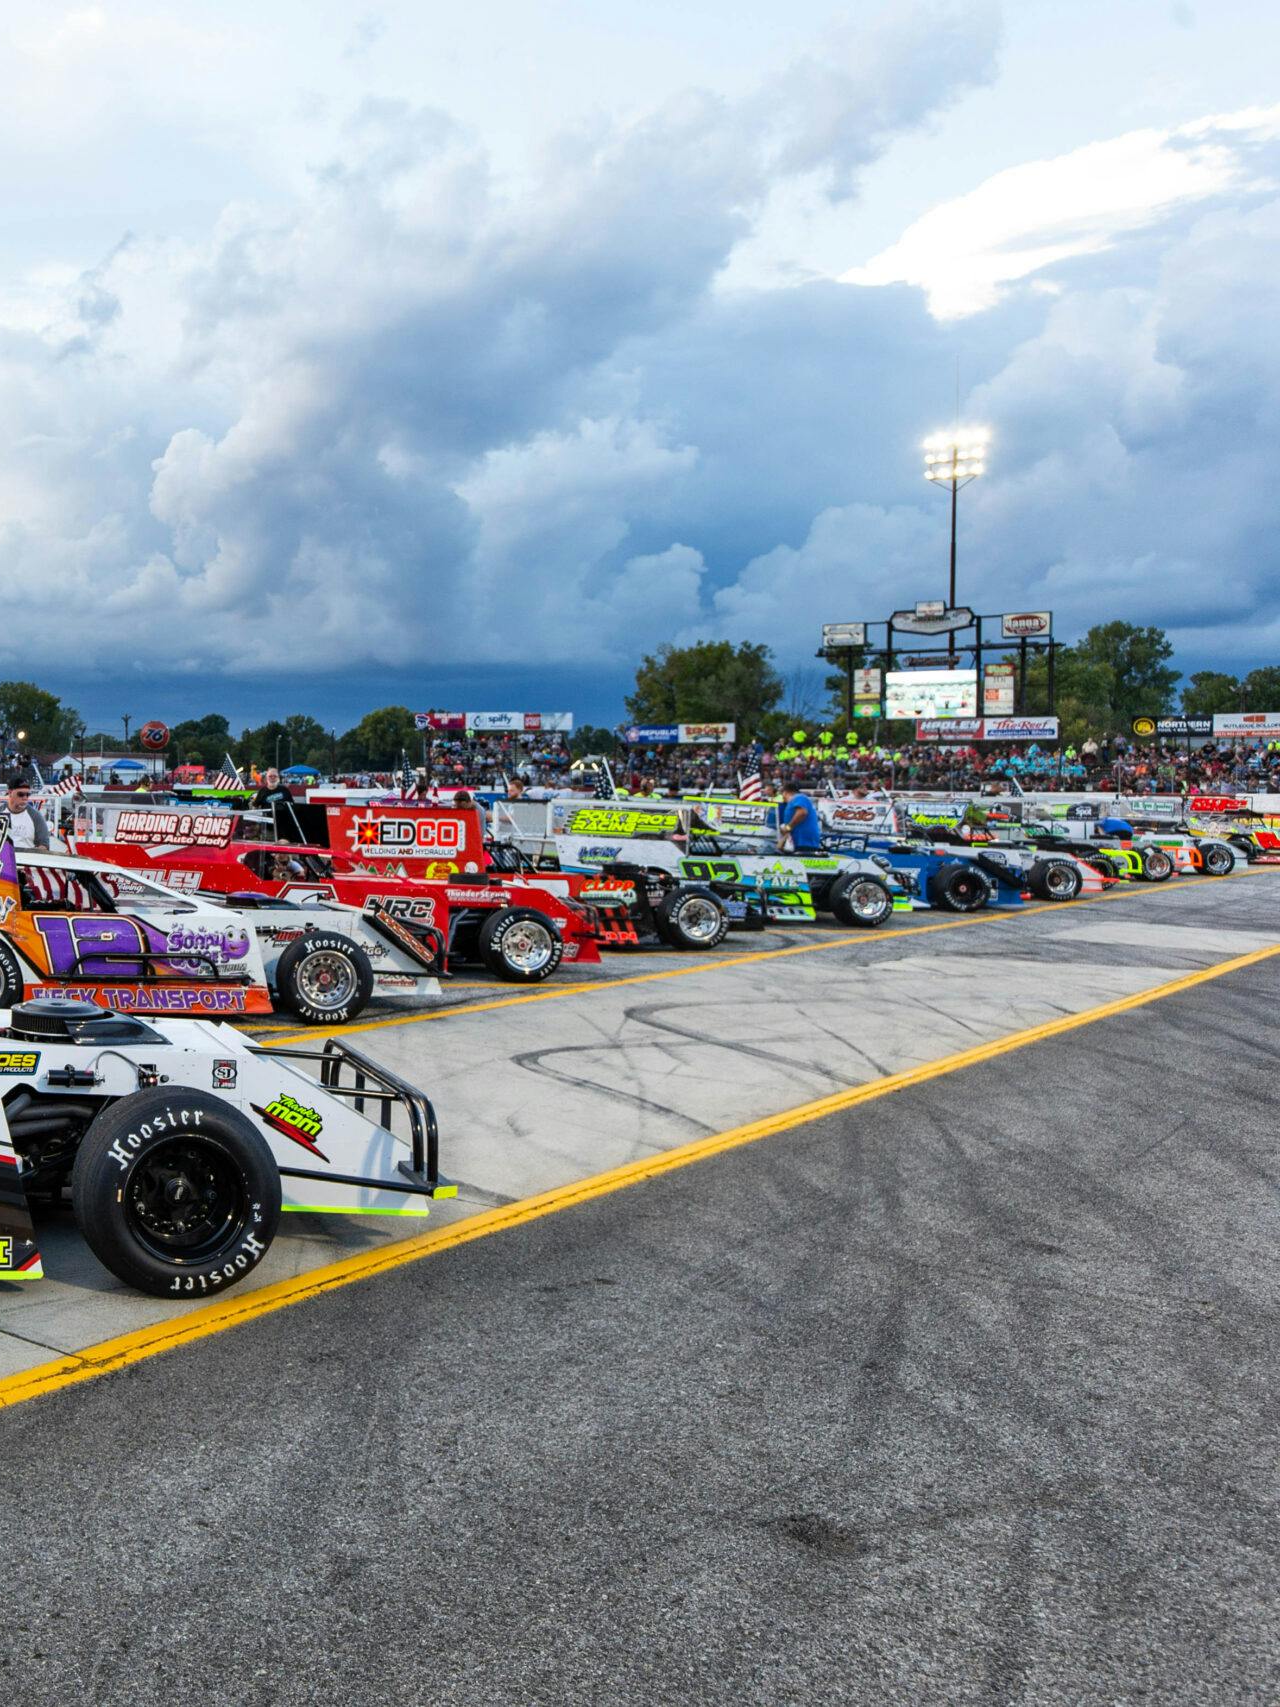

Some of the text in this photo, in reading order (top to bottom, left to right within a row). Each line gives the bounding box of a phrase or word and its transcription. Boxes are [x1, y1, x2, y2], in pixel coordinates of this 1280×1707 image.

[487, 713, 513, 724] spiffy
[993, 718, 1049, 730] The Reef
[143, 727, 166, 742] 76
[118, 811, 232, 836] HARDING & SONS
[571, 821, 637, 833] RACING
[116, 832, 229, 848] Paint & Auto Body
[380, 819, 459, 847] EDCO
[363, 847, 455, 857] WELDING AND HYDRAULIC
[490, 915, 516, 953] Hoosier
[304, 938, 355, 955] Hoosier
[102, 988, 248, 1011] TRANSPORT
[108, 1106, 204, 1170] Hoosier
[170, 1232, 265, 1291] Hoosier
